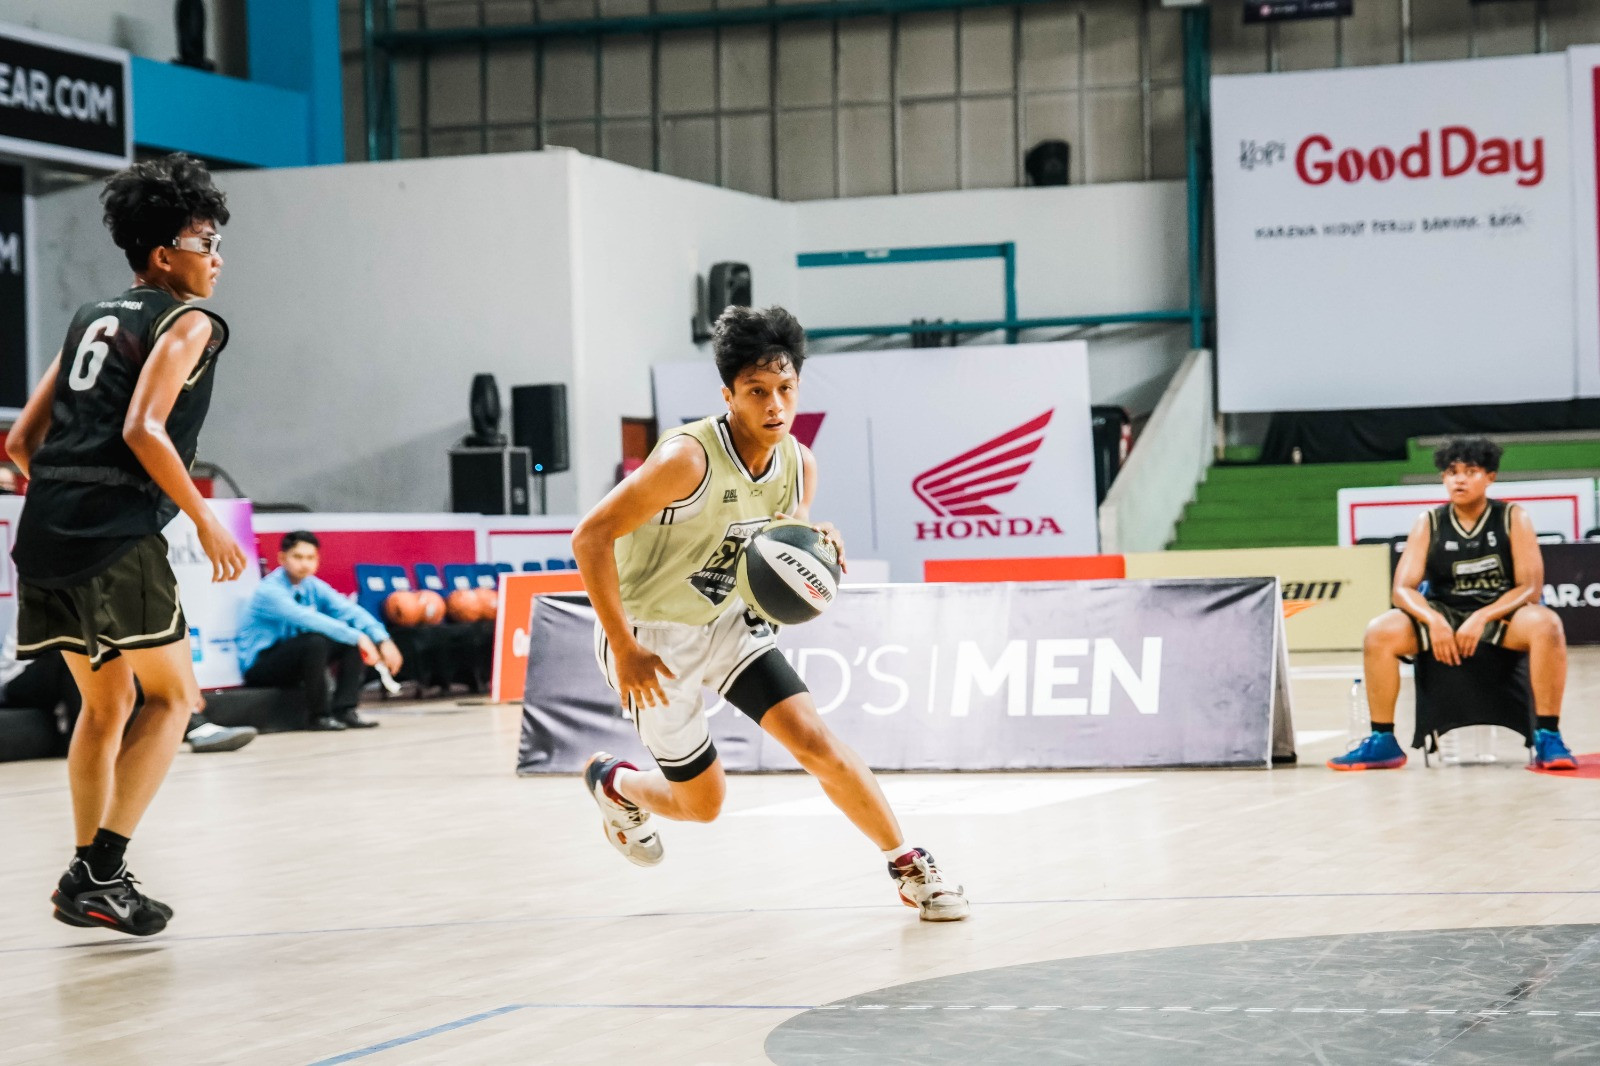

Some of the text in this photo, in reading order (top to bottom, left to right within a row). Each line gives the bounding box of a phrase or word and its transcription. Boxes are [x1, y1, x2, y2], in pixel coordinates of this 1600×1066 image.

[1295, 129, 1431, 185] Good
[1440, 125, 1546, 188] Day
[68, 315, 119, 391] 6
[915, 516, 1064, 541] HONDA
[775, 551, 833, 604] proteam
[950, 637, 1163, 717] MEN
